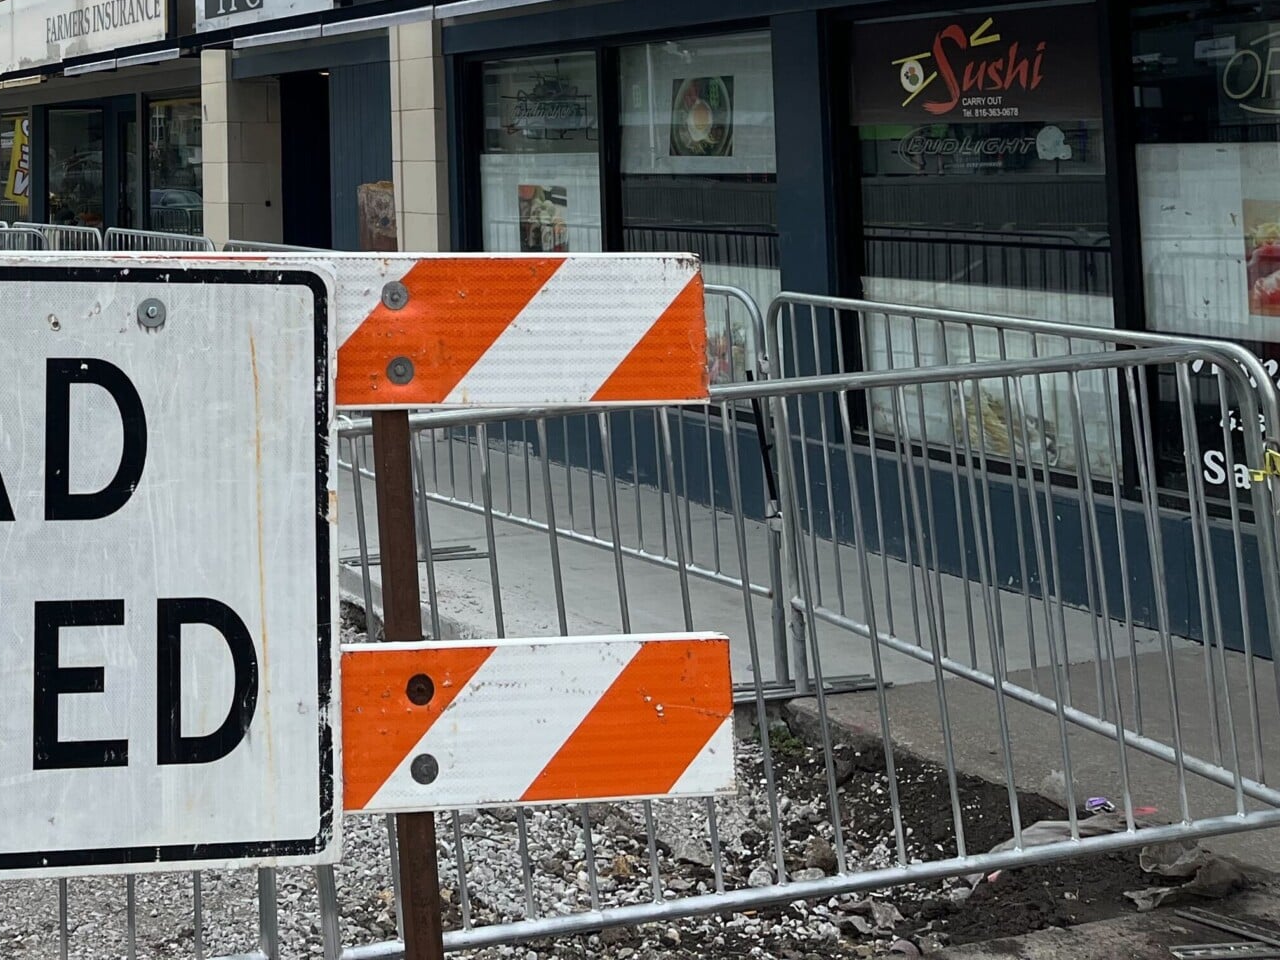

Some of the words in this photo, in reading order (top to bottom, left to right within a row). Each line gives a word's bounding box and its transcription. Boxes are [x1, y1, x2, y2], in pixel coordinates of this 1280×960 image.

[46, 6, 91, 43] FARMERS
[922, 24, 1047, 115] Sushi
[962, 96, 986, 106] CARRY
[987, 95, 1002, 105] OUT
